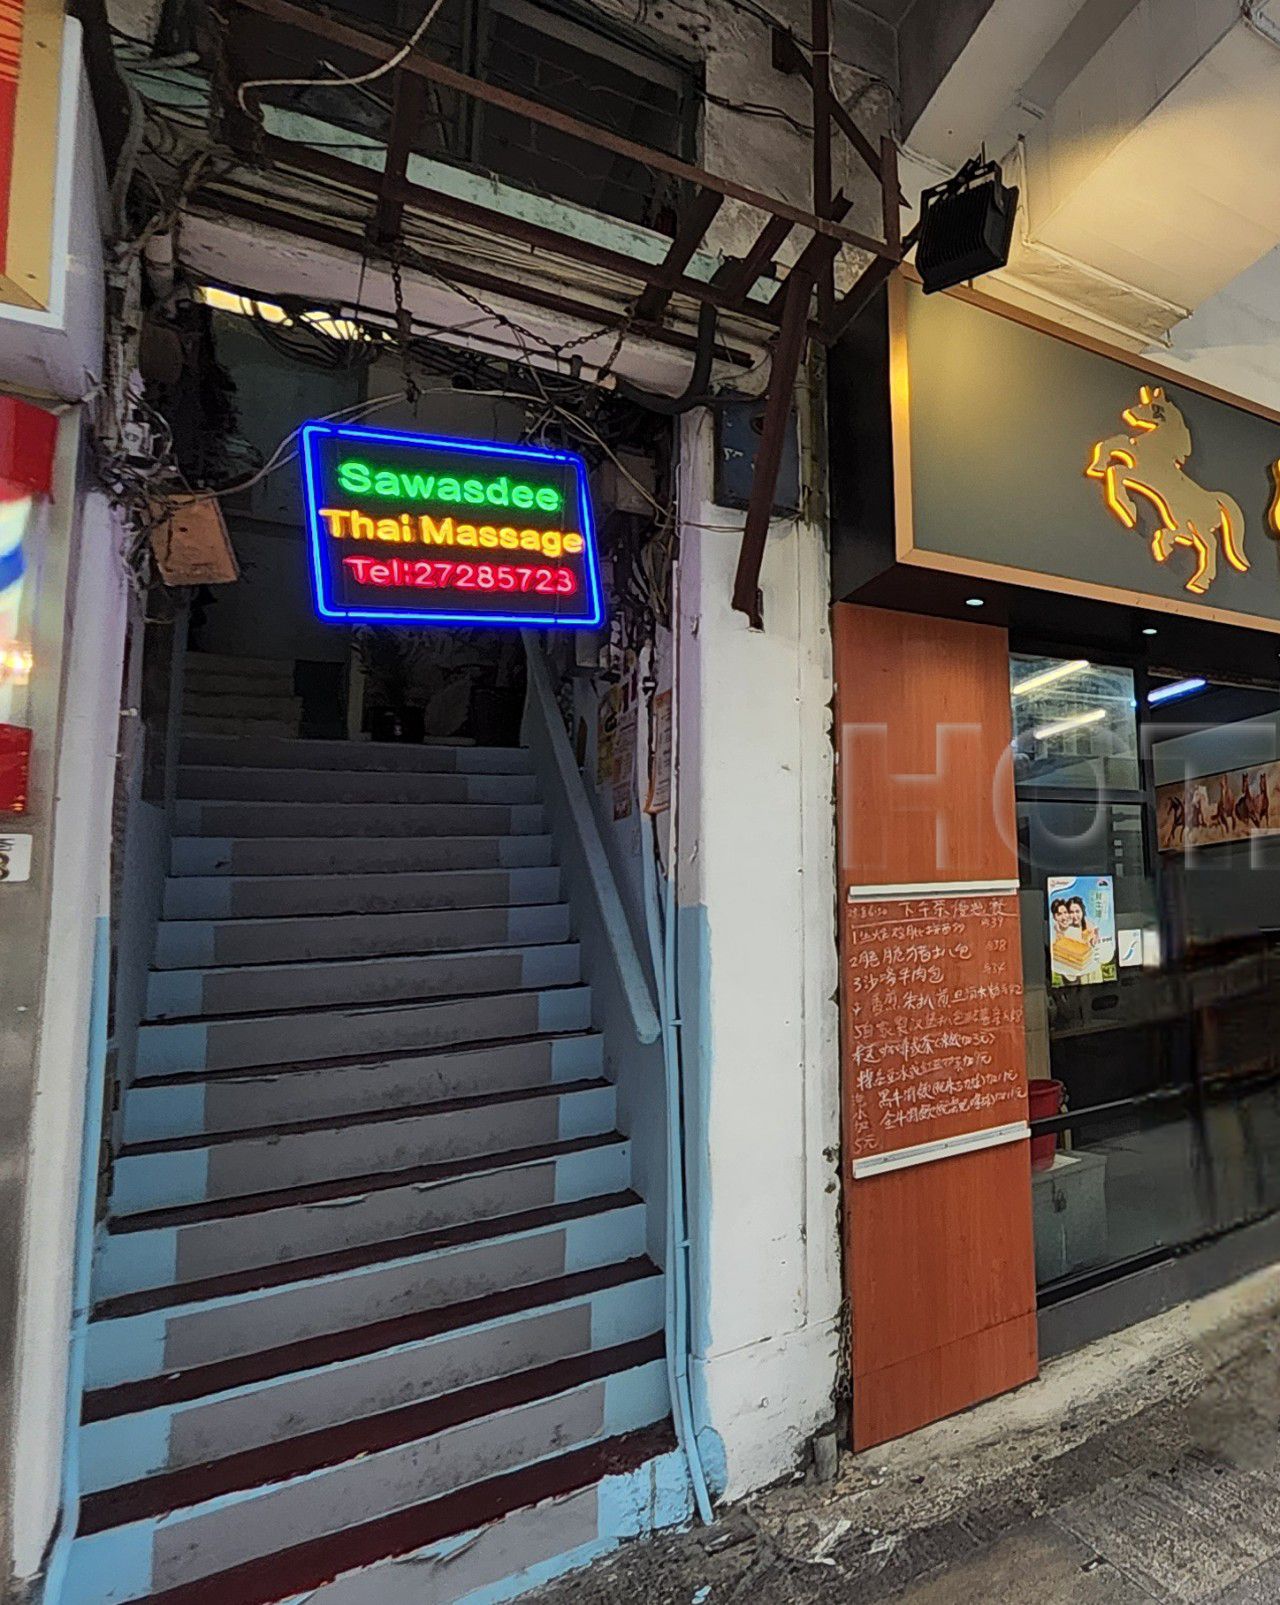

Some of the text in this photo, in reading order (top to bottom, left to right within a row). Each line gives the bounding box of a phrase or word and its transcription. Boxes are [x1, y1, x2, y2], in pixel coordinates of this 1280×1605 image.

[337, 461, 564, 513] Sawasdee
[319, 507, 586, 557] Thai Massage
[343, 556, 578, 596] Tel:27285723
